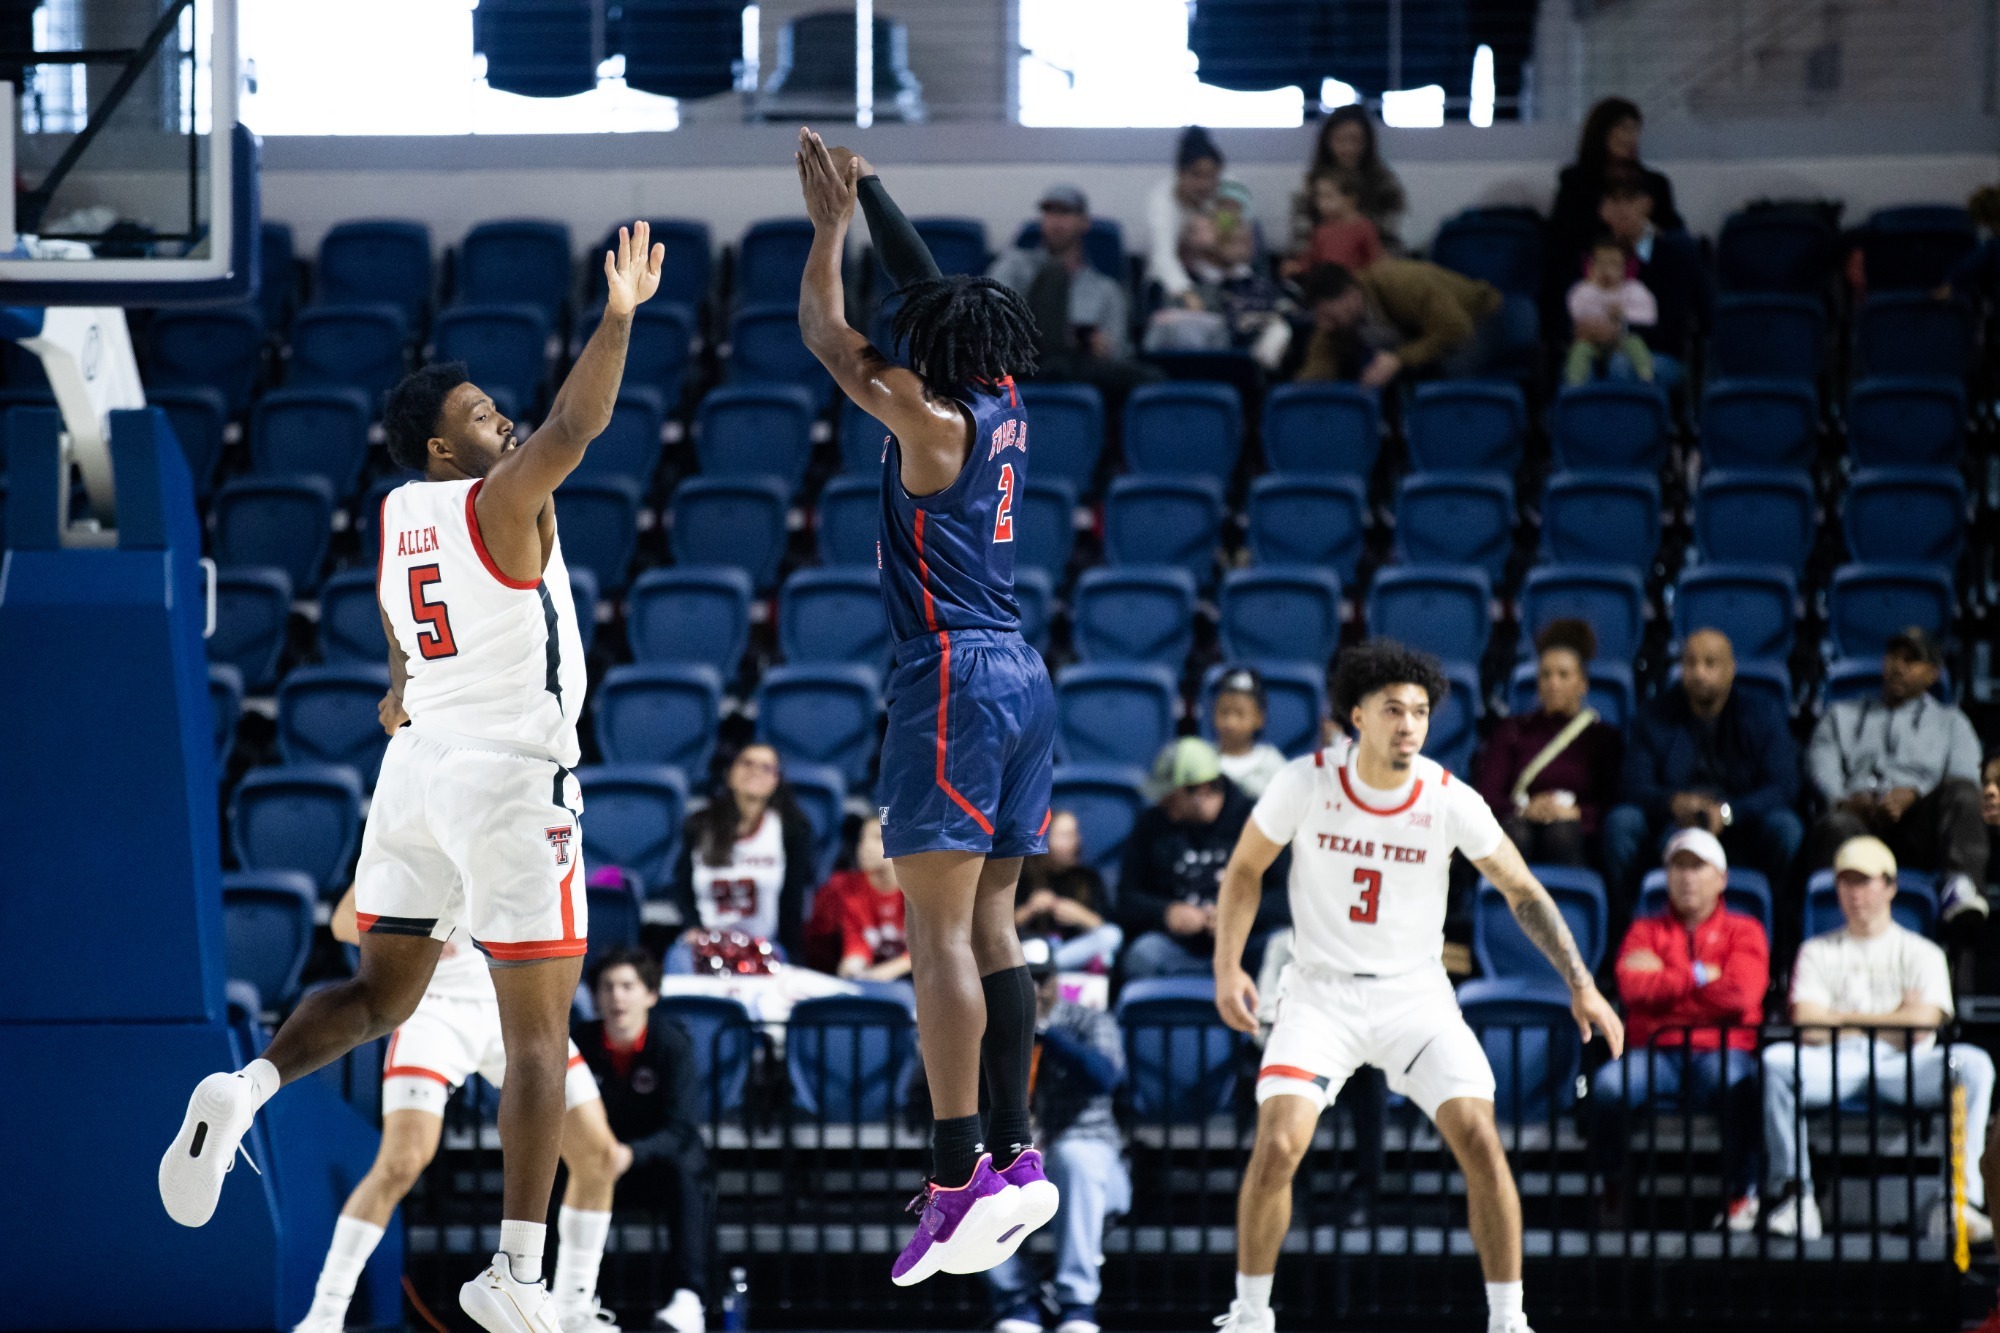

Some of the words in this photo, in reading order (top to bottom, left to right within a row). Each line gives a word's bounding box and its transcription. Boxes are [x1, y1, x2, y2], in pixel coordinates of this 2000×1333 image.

[992, 463, 1015, 544] 2
[398, 526, 440, 556] ALLEN
[408, 563, 458, 660] 5
[1317, 833, 1375, 858] TEXAS
[1382, 844, 1427, 863] TECH
[1349, 867, 1383, 925] 3
